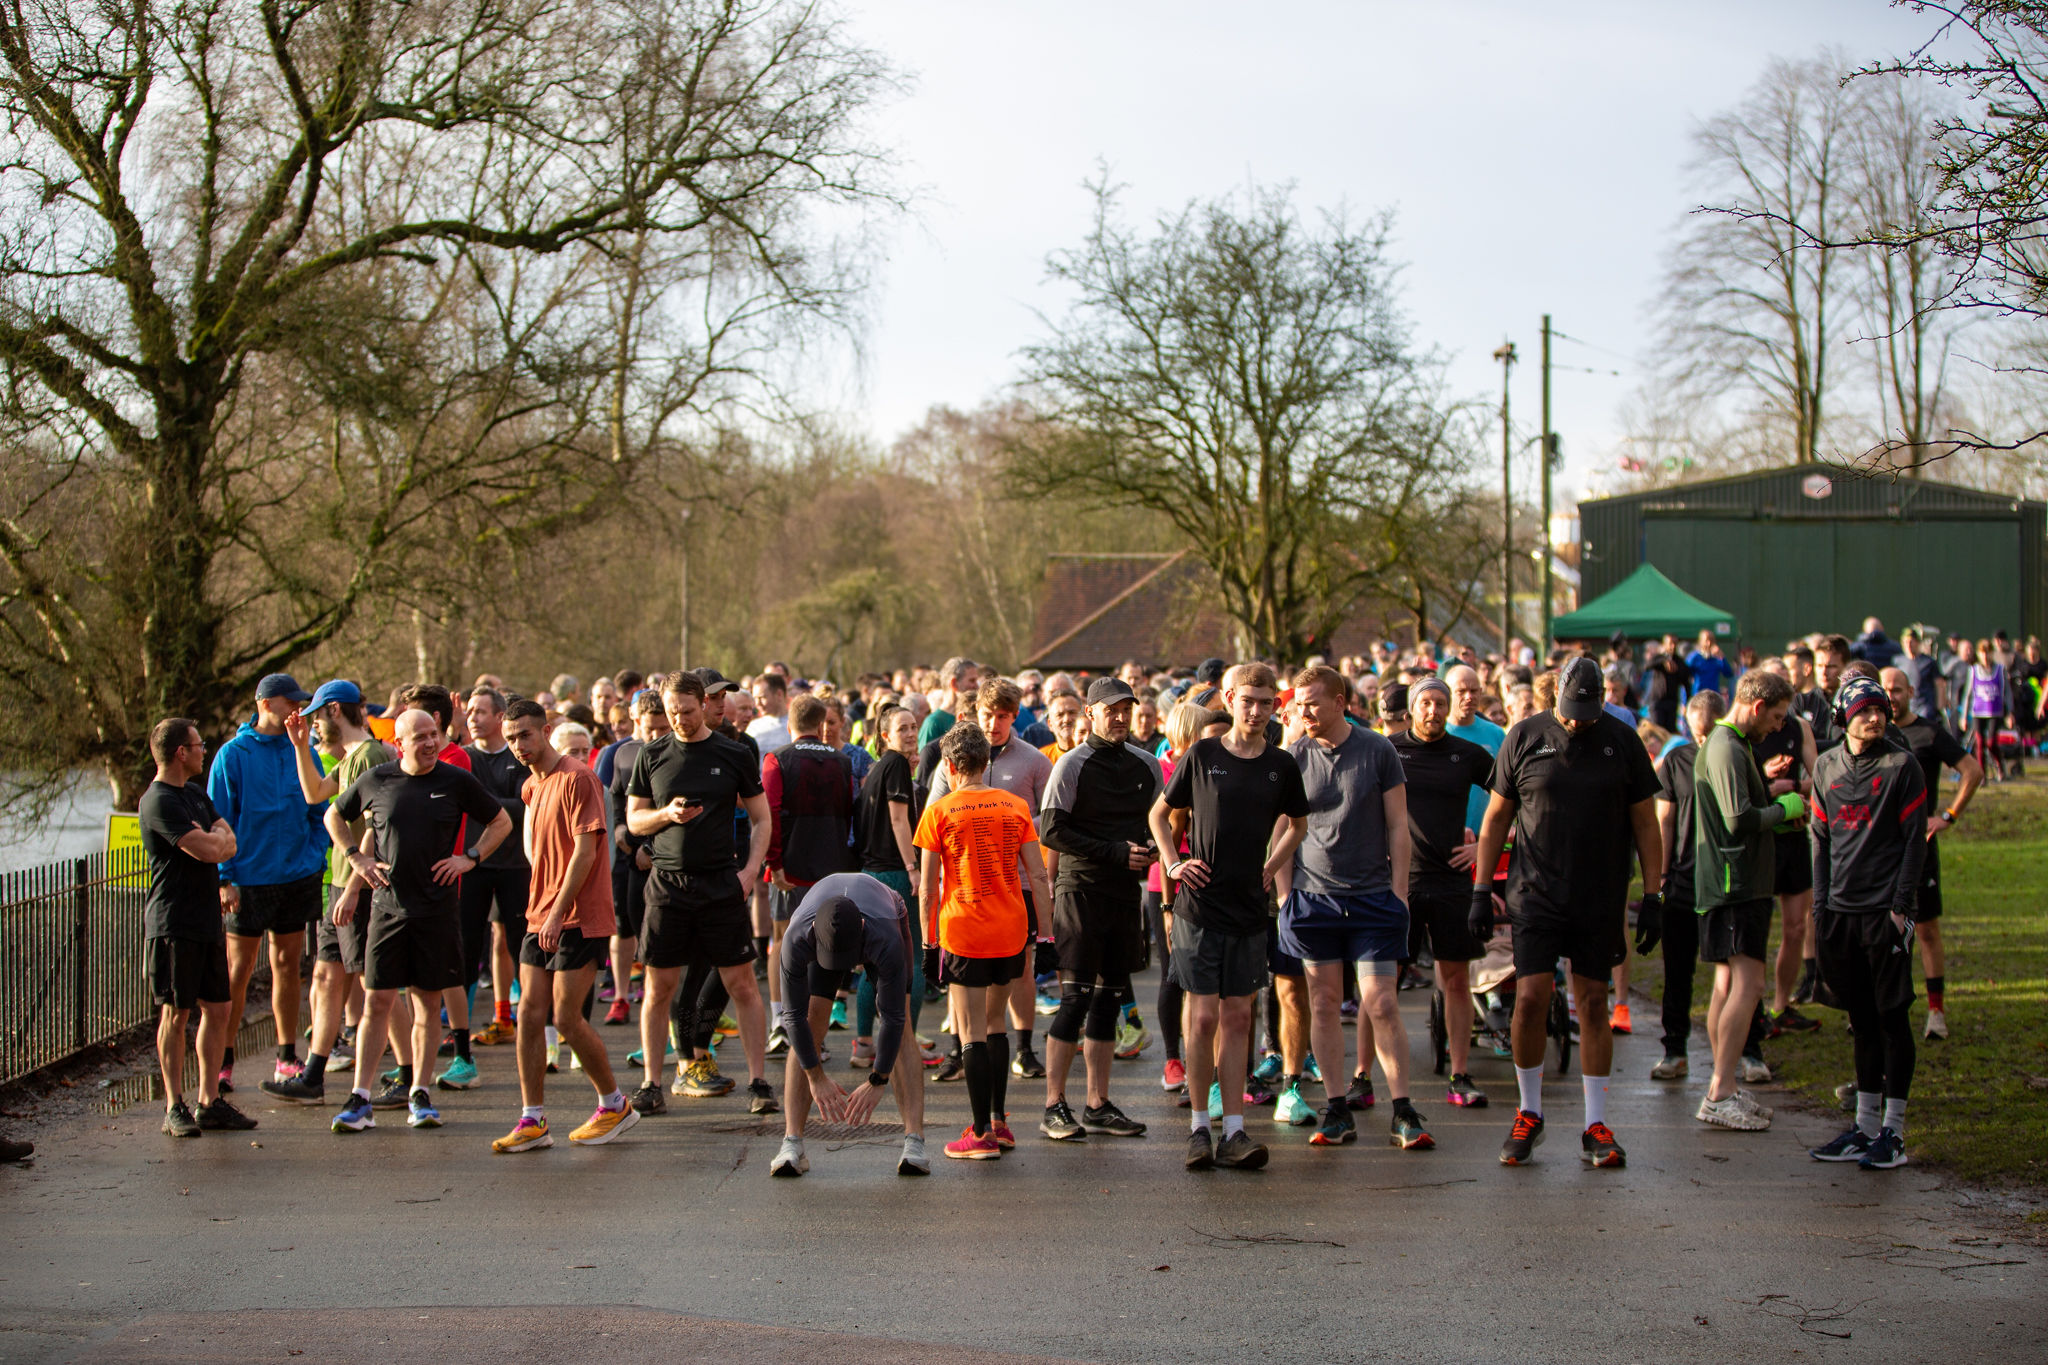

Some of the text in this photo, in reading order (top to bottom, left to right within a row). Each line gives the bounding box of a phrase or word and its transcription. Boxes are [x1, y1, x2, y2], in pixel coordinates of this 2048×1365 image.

[795, 743, 826, 751] adidas
[1536, 744, 1557, 755] parkrun
[950, 804, 976, 814] Bushy
[978, 801, 998, 809] Park
[1830, 804, 1872, 831] AXA
